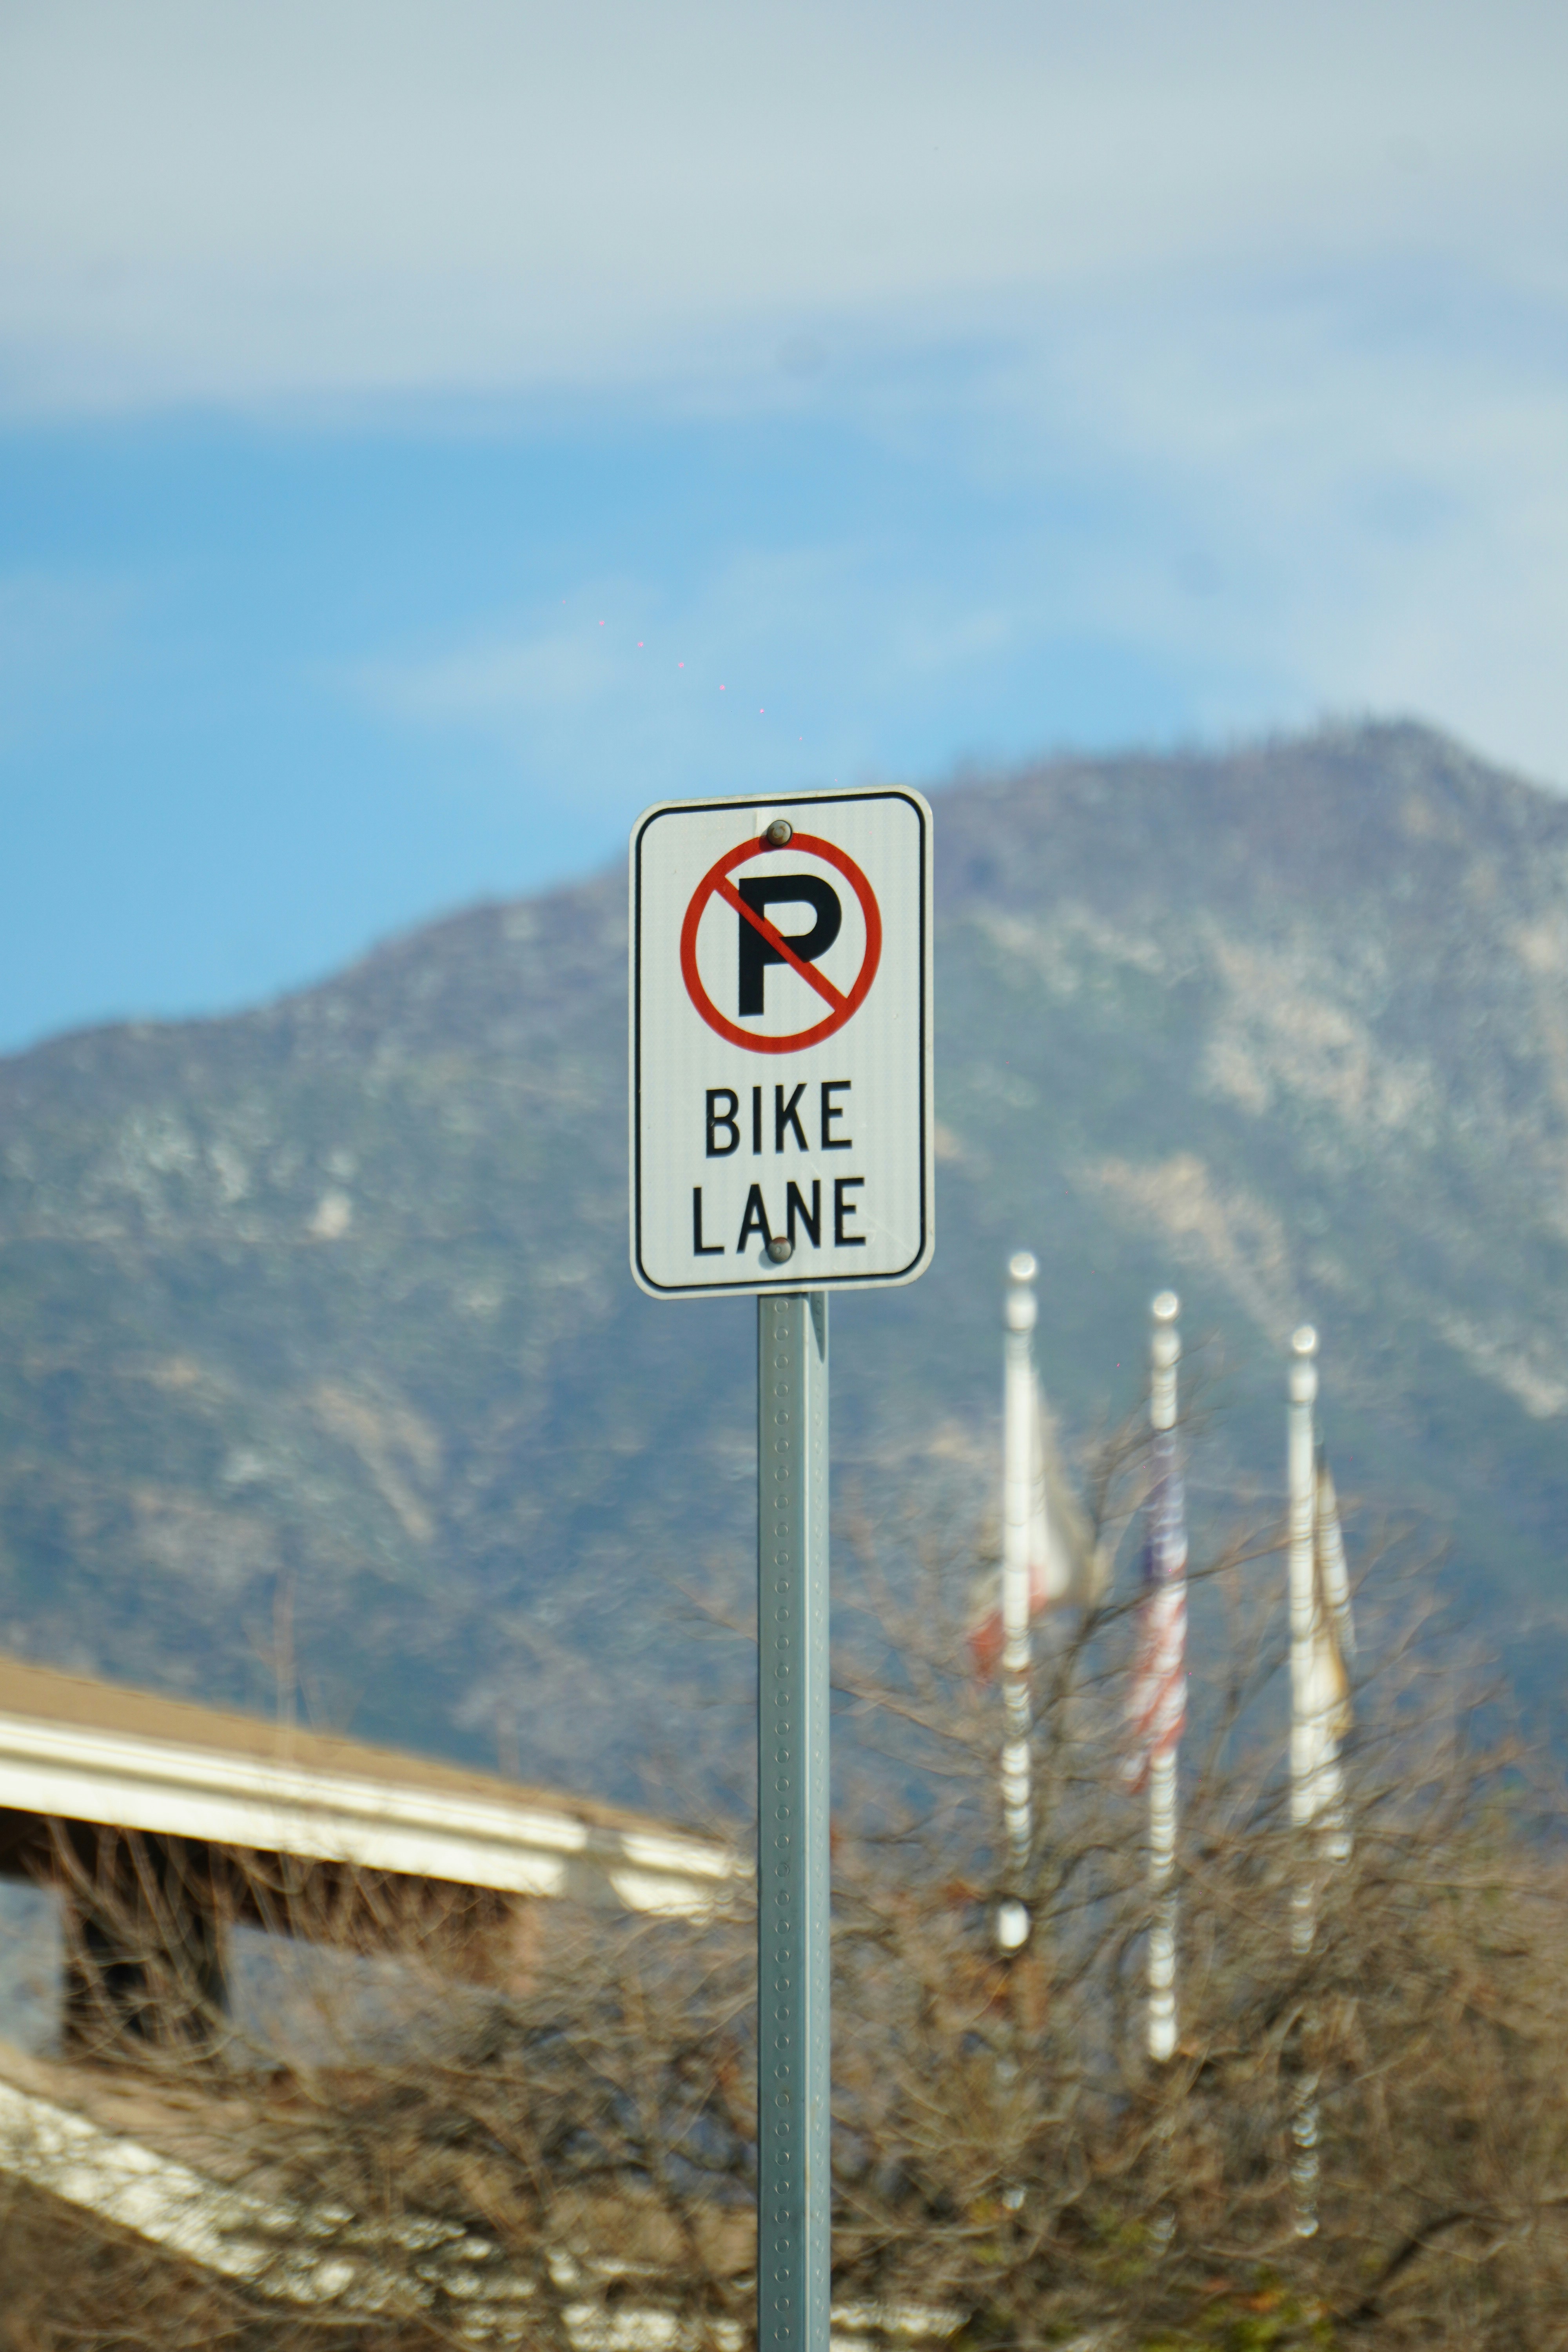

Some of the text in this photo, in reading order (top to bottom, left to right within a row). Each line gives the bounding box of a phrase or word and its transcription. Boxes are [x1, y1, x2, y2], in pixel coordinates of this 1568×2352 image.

[739, 875, 842, 1017] P
[706, 1080, 853, 1158] BIKE
[693, 1177, 866, 1257] LANE
